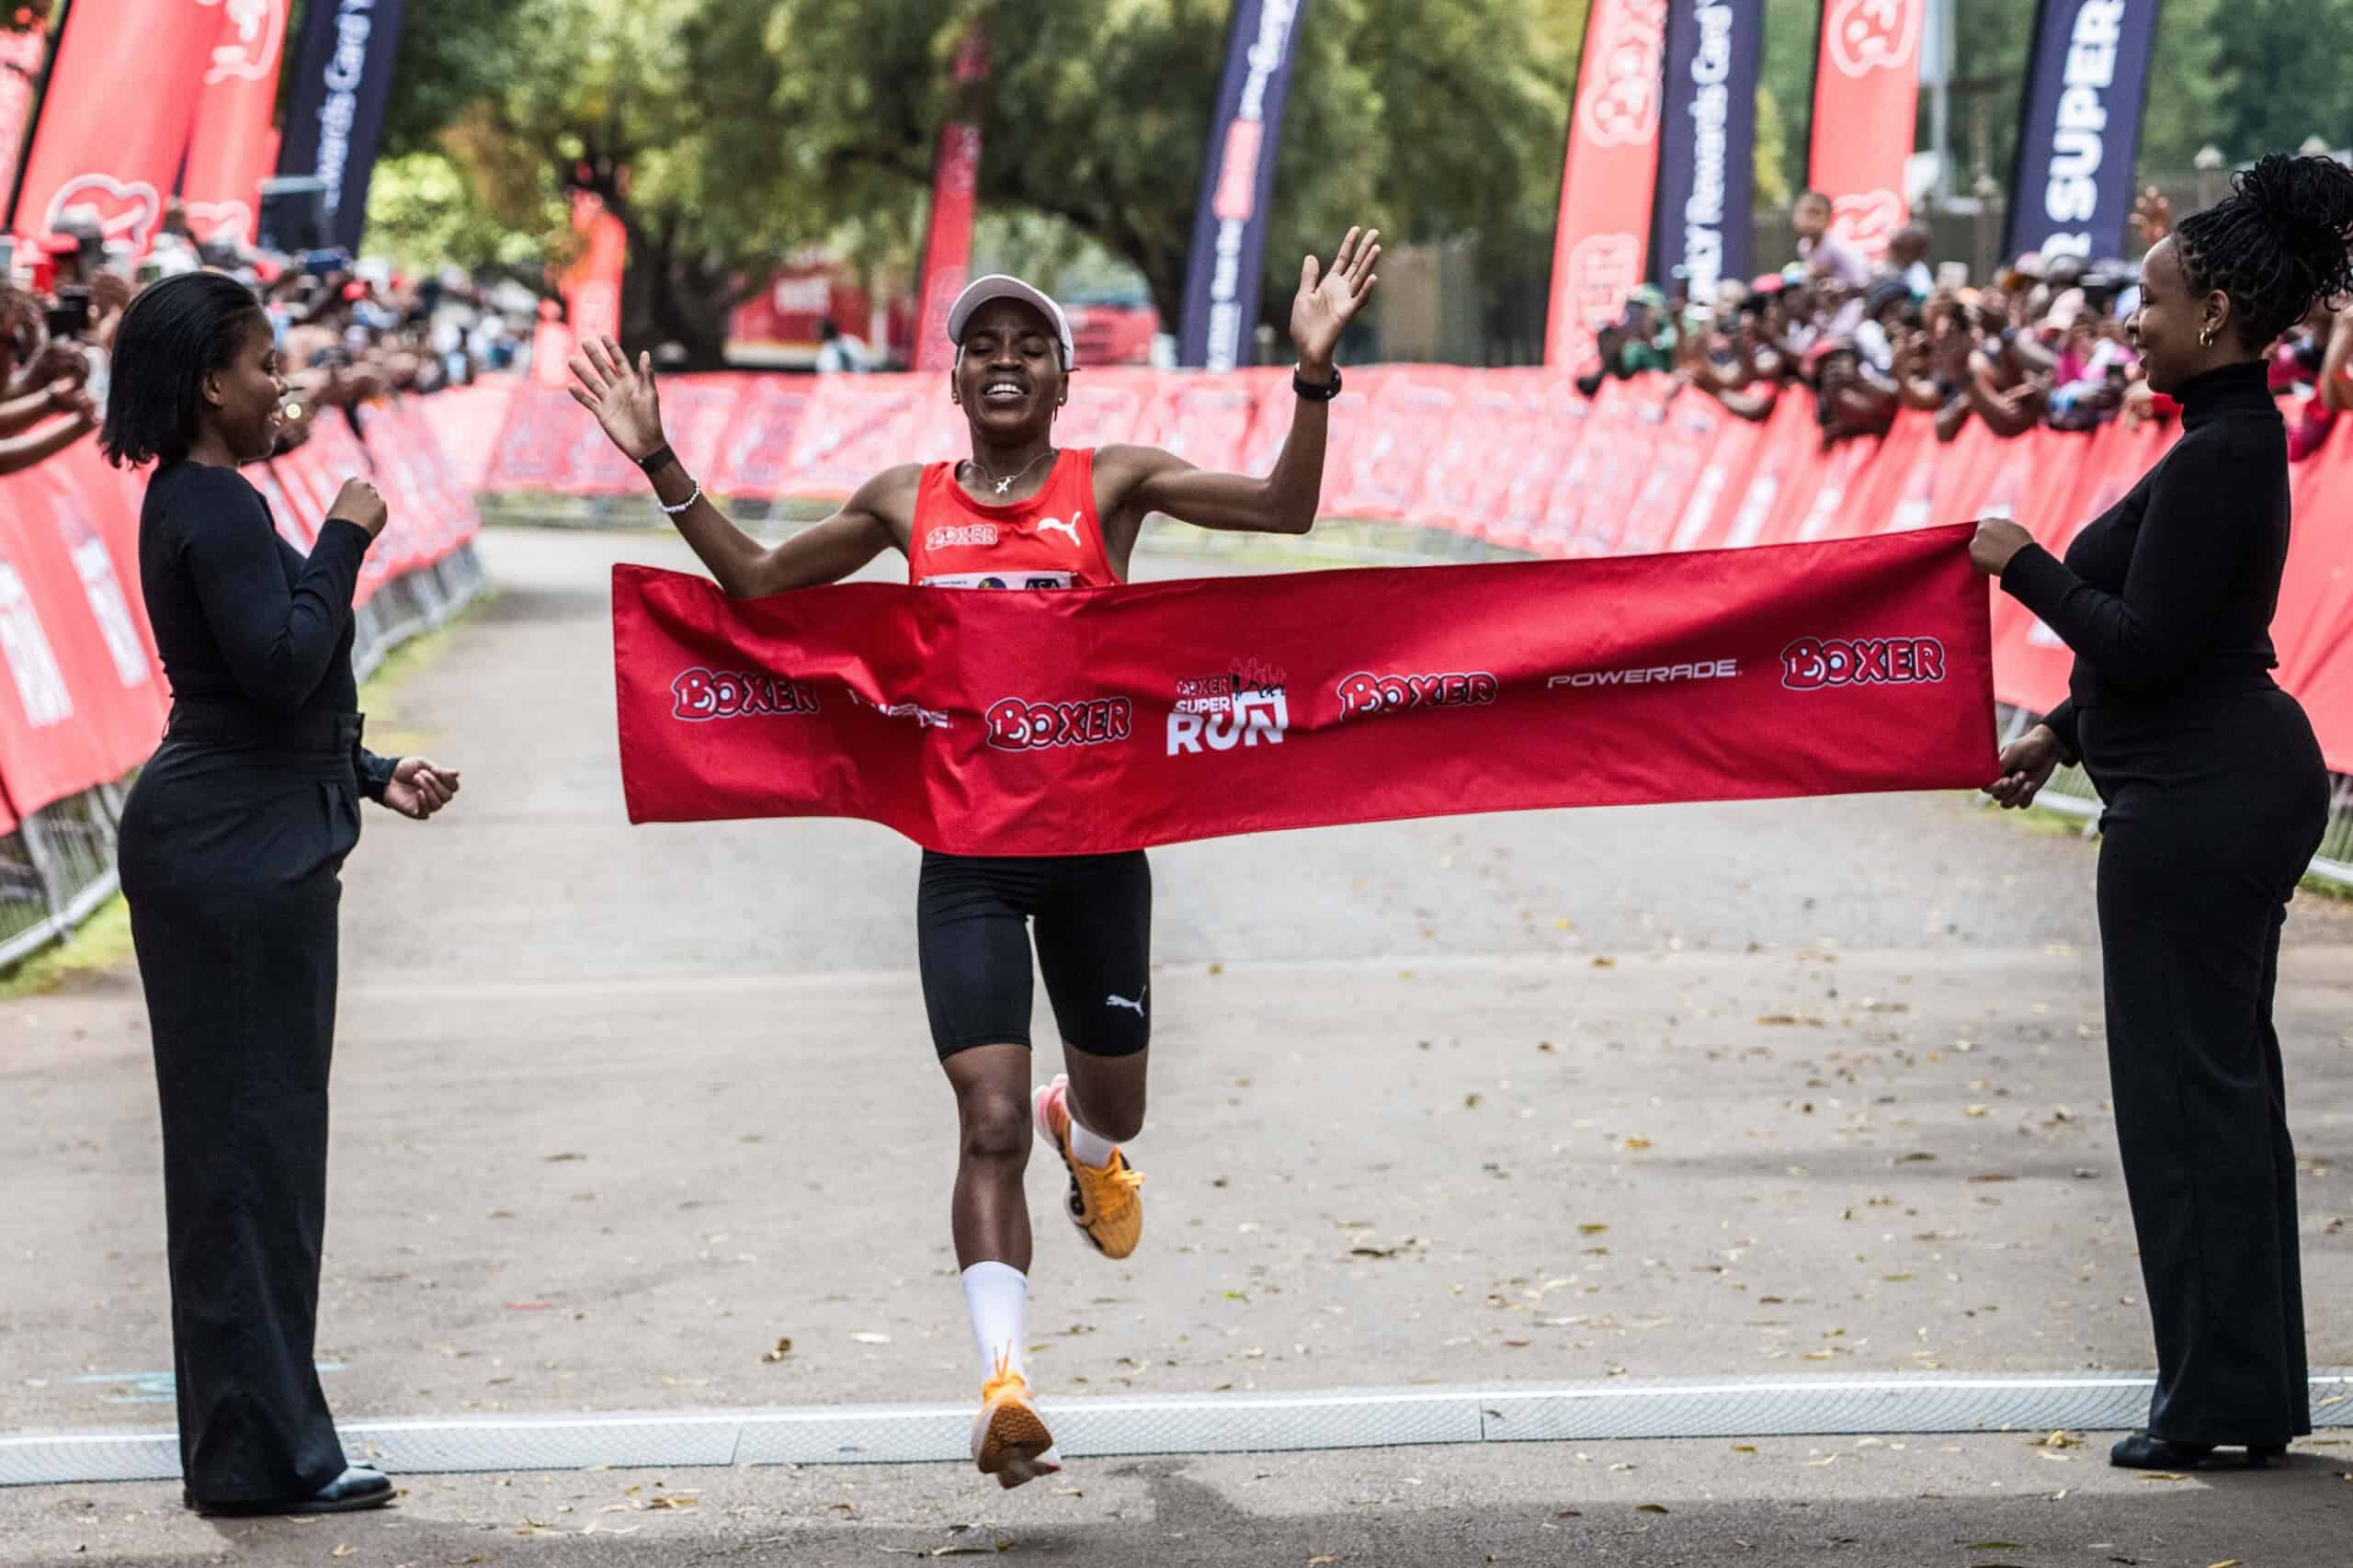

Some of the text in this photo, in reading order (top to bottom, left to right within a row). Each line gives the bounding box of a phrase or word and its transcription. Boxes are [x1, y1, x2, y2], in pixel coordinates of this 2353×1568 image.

[323, 12, 371, 92] Card
[1691, 5, 1733, 85] Card
[2044, 0, 2125, 222] SUPER
[1176, 676, 1231, 697] BOXER
[1547, 658, 1737, 689] POWERADE
[1779, 635, 1946, 691] BOXER
[670, 666, 821, 722] BOXER
[1166, 687, 1290, 756] RUN
[1174, 696, 1232, 714] SUPER
[1337, 670, 1498, 722] BOXER
[985, 696, 1132, 752] BOXER
